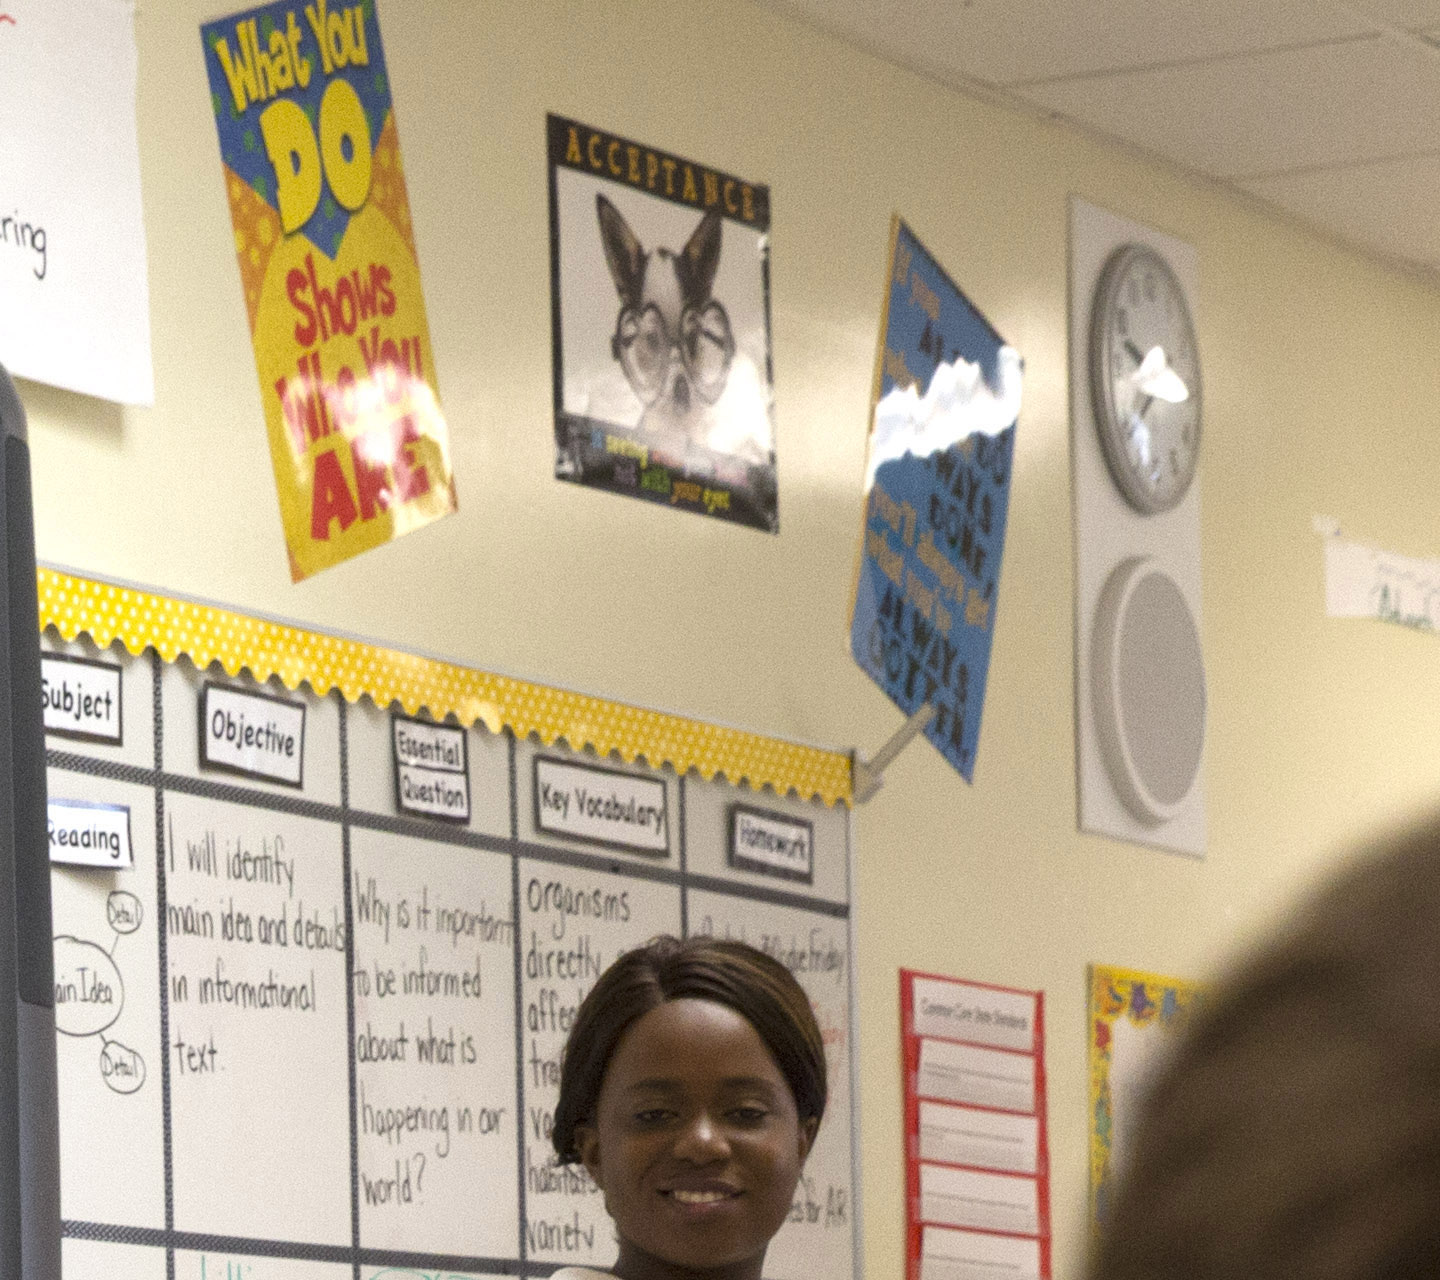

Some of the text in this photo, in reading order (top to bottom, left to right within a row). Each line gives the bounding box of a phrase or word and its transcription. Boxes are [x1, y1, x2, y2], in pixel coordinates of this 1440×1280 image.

[216, 0, 369, 112] What You
[259, 78, 373, 234] DO
[565, 126, 755, 221] ACCEPTANCE
[286, 251, 397, 347] Shows
[41, 679, 296, 758] Subject Objective
[398, 730, 460, 768] Essential
[402, 774, 465, 810] Question
[540, 782, 666, 836] Key Vocabulary
[168, 812, 294, 898] I will identify
[740, 816, 809, 861] Homework
[168, 897, 345, 952] main idea and details
[355, 869, 391, 943] Why
[396, 895, 410, 930] is
[417, 884, 431, 932] it
[527, 877, 631, 940] organisms
[77, 967, 113, 1005] Idea
[171, 955, 316, 1012] in informational
[376, 957, 397, 999] be
[402, 944, 482, 999] informed
[356, 1018, 410, 1065] about
[416, 1014, 457, 1066] what
[461, 1034, 477, 1065] is
[360, 1080, 450, 1159] happening
[457, 1106, 473, 1133] in
[479, 1106, 506, 1136] our
[361, 1151, 426, 1206] world?
